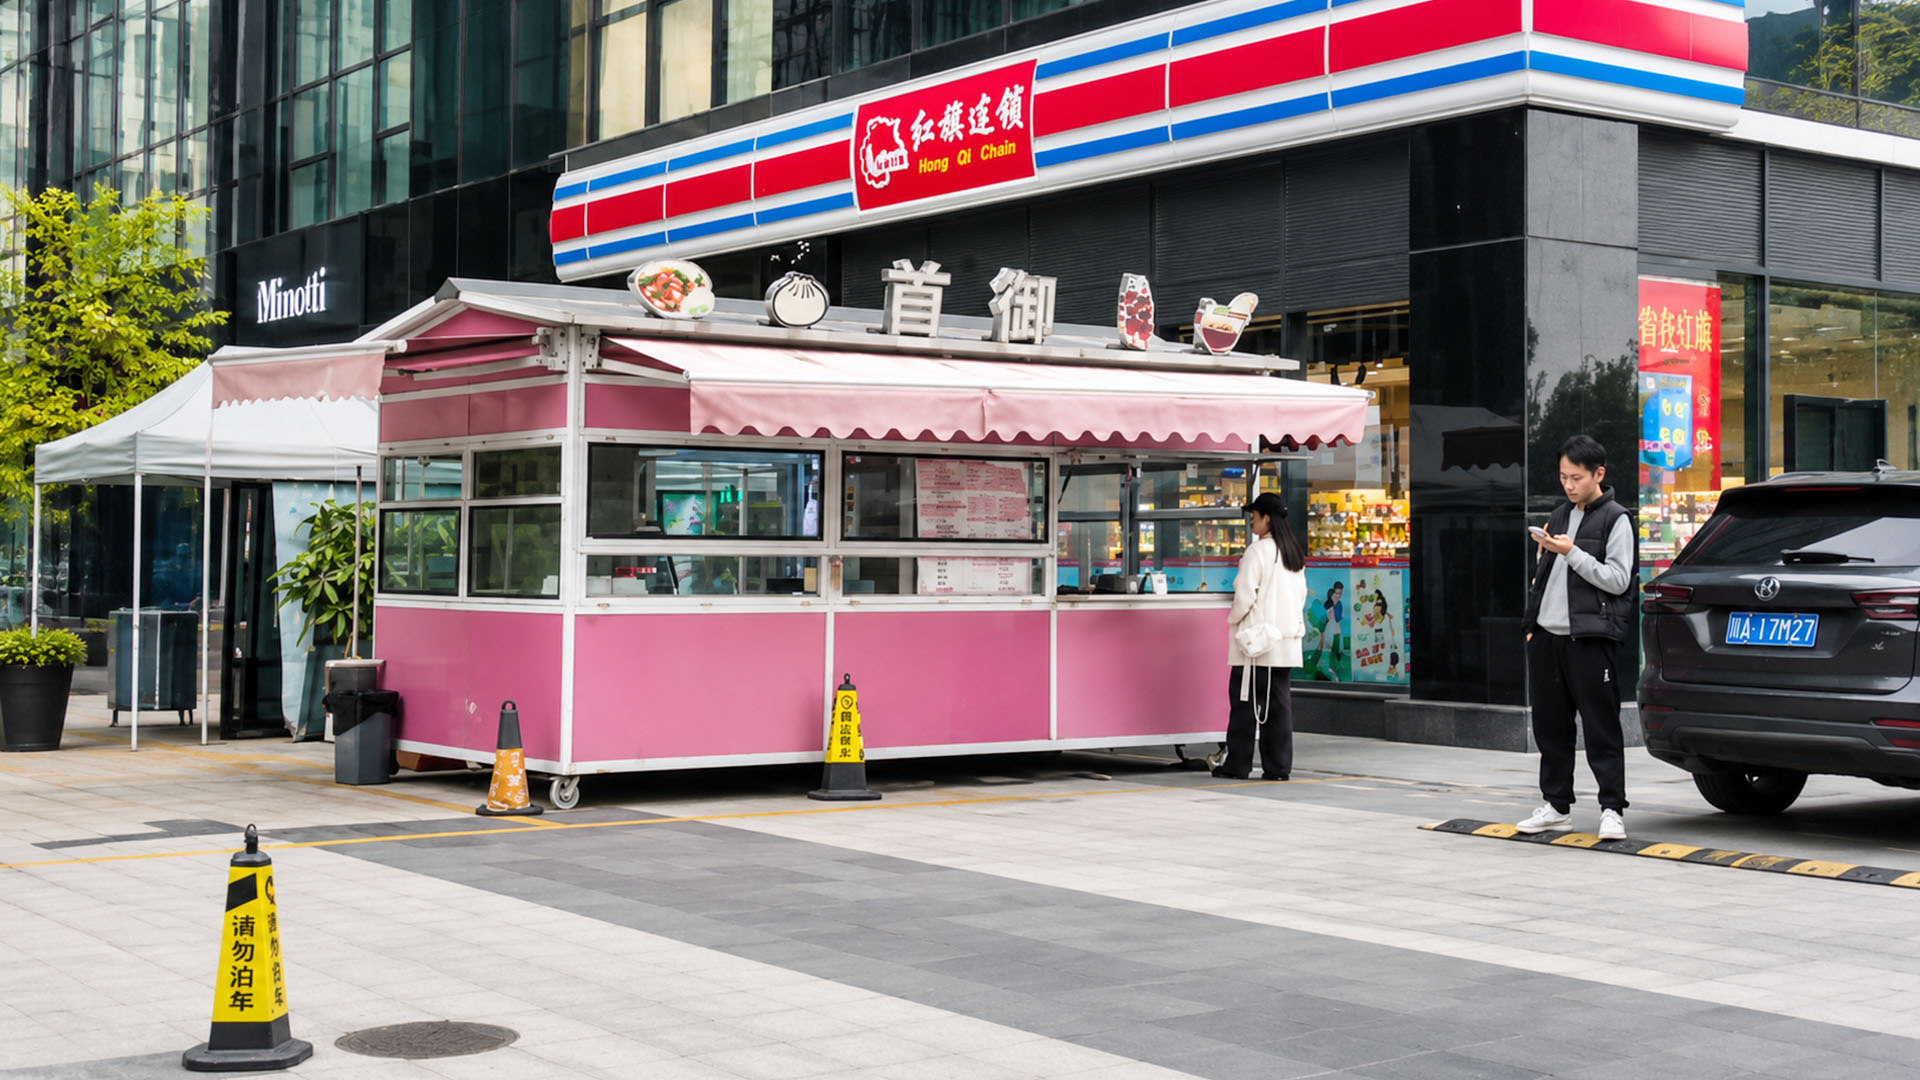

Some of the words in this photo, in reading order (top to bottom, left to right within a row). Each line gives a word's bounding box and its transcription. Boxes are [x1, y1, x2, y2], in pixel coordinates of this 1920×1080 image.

[919, 155, 949, 174] Hong
[957, 148, 972, 167] Qi
[980, 140, 1017, 161] Chain
[256, 266, 327, 324] Minotti
